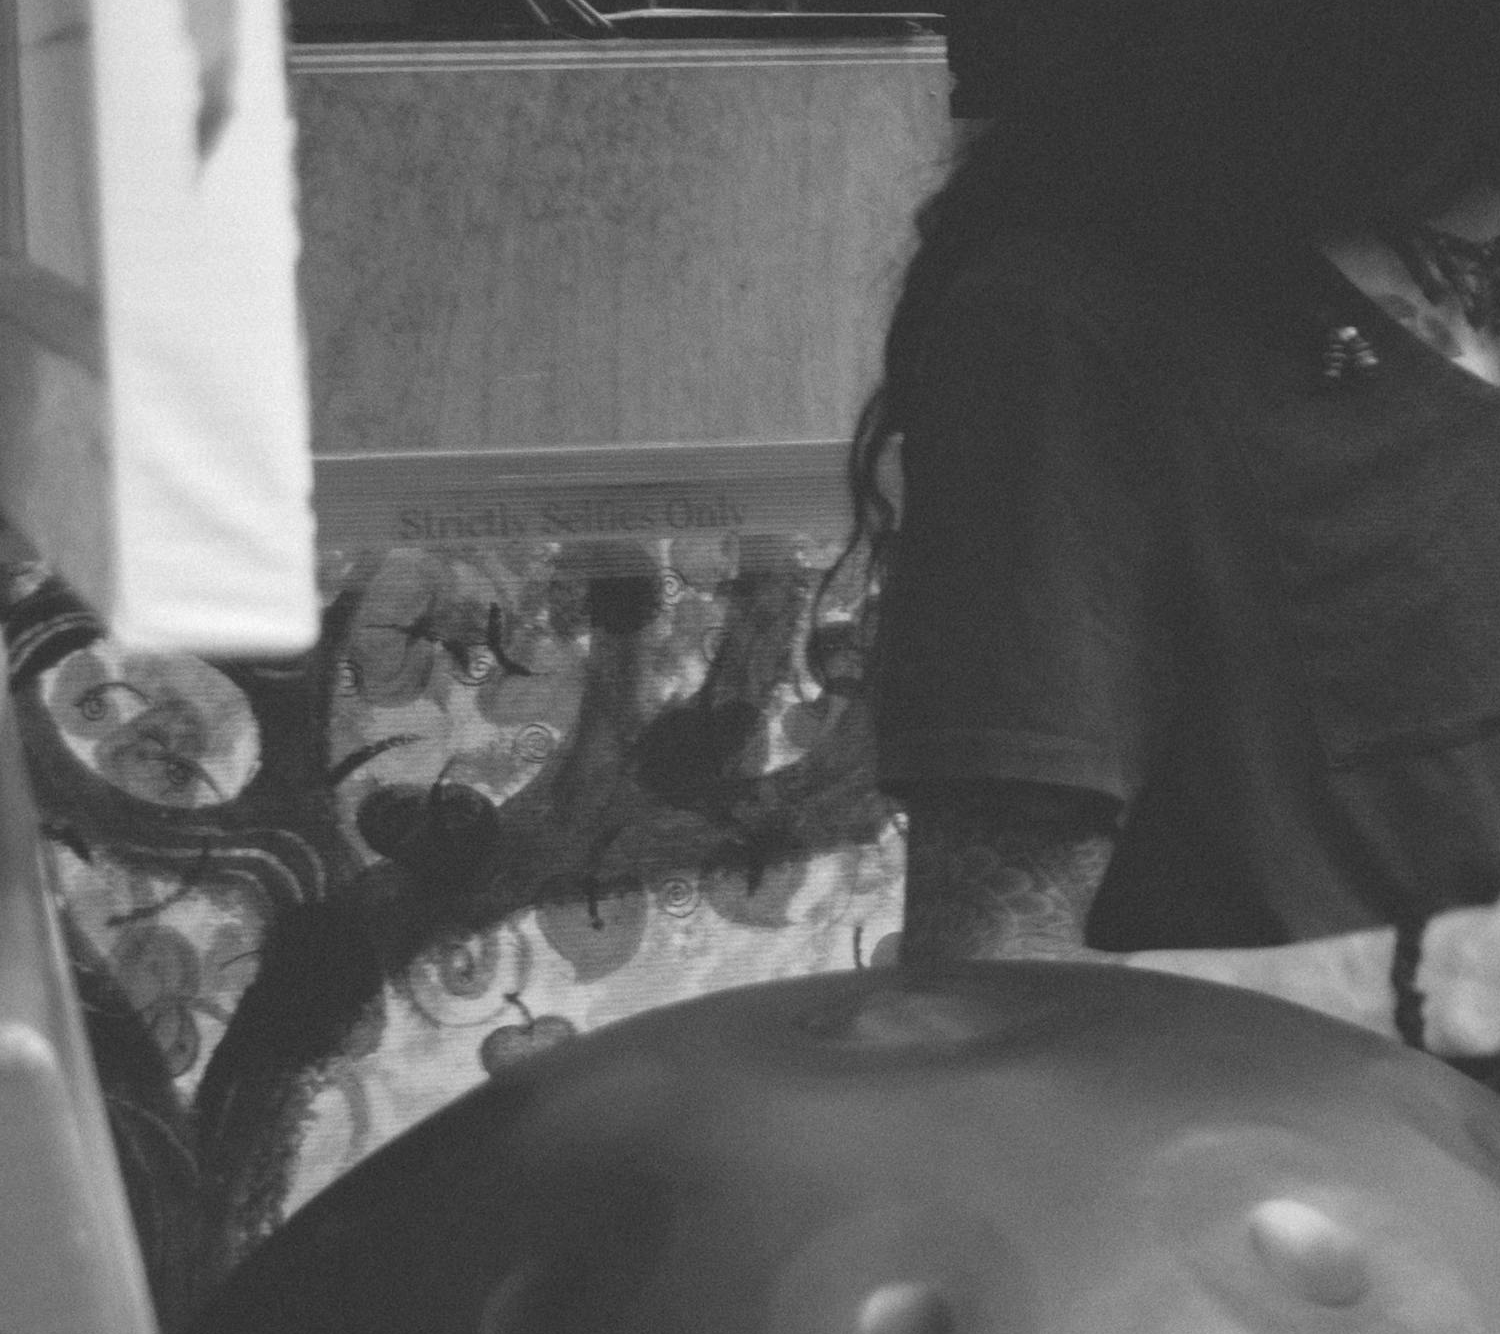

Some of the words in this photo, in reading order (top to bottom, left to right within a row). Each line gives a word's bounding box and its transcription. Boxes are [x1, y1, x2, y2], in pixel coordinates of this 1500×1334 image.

[398, 502, 529, 542] Strictly
[540, 498, 656, 534] Selfies
[664, 493, 749, 531] Only
